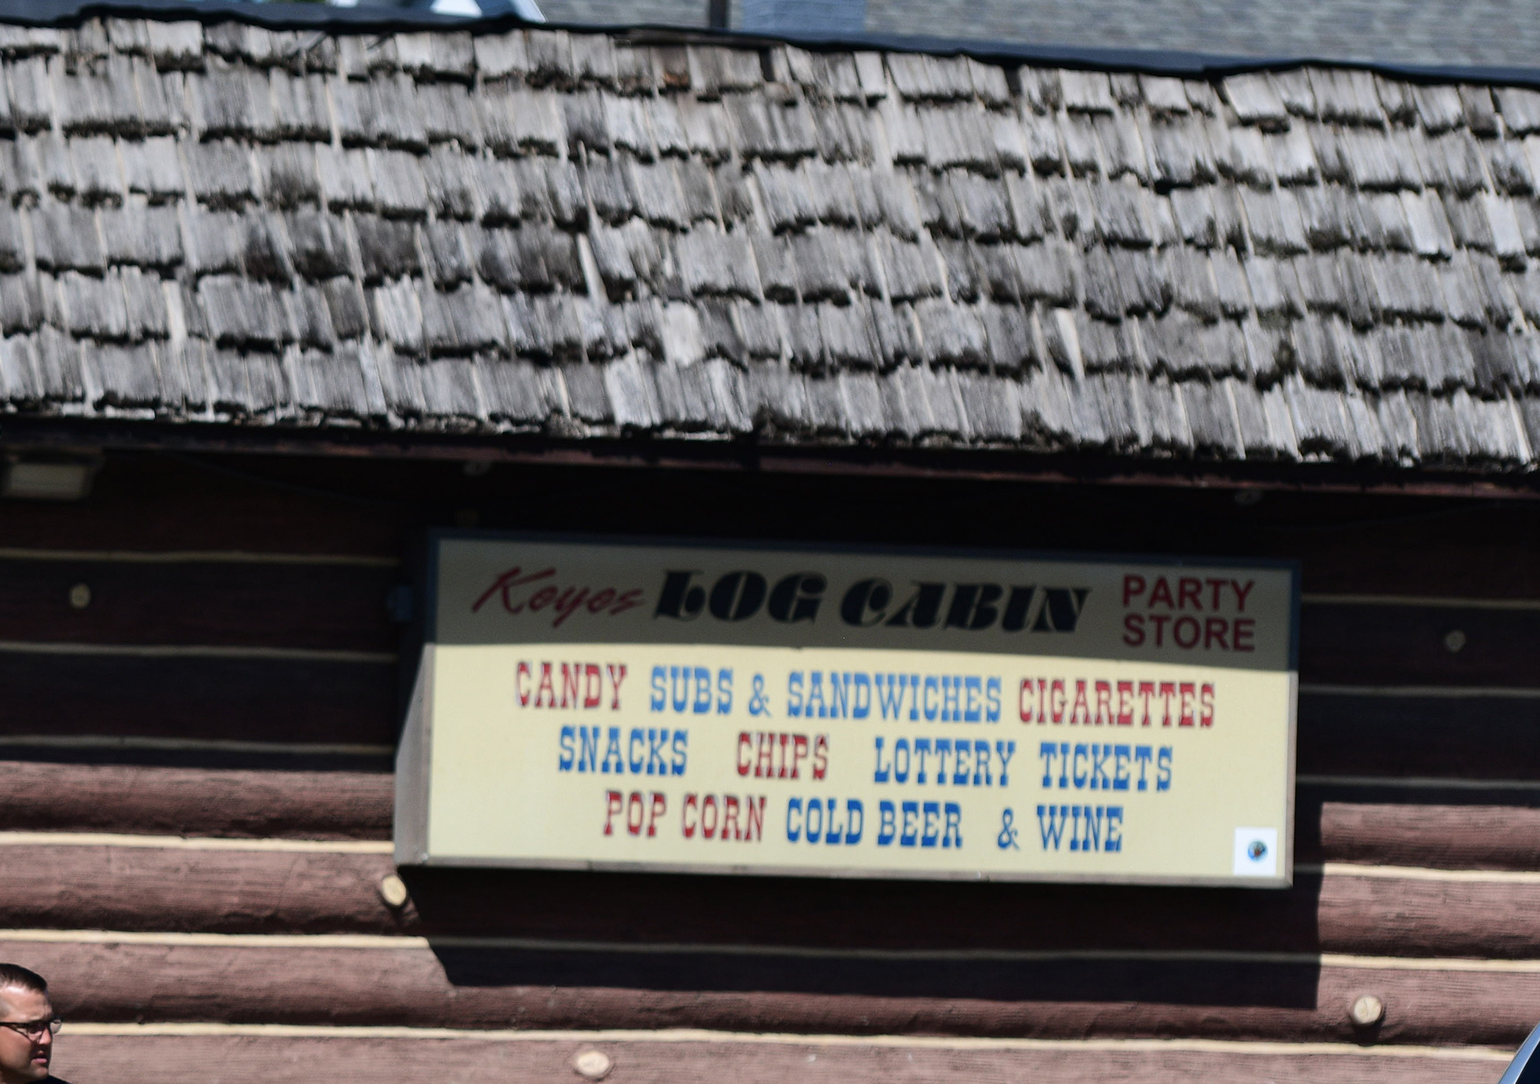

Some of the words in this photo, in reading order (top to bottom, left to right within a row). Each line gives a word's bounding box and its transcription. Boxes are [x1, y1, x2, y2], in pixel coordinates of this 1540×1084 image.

[653, 569, 828, 624] LOG
[839, 577, 1092, 633] CABIN
[1121, 574, 1255, 611] PARTY
[1122, 613, 1256, 652] STORE
[516, 661, 628, 710] CANDY
[650, 665, 733, 715] SUBS
[748, 673, 771, 717] &
[787, 670, 1002, 723] SANDWICHES
[1019, 677, 1215, 728] CIGARETTES
[559, 725, 688, 776] SNACKS
[736, 731, 829, 780] CHIPS
[874, 737, 1016, 786] LOTTERY
[1040, 741, 1173, 791] TICKETS
[603, 790, 667, 838] POP
[682, 793, 767, 841] CORN
[787, 797, 864, 845] COLD
[877, 800, 962, 848] BEER
[997, 807, 1020, 850] &
[1037, 805, 1124, 853] WINE
